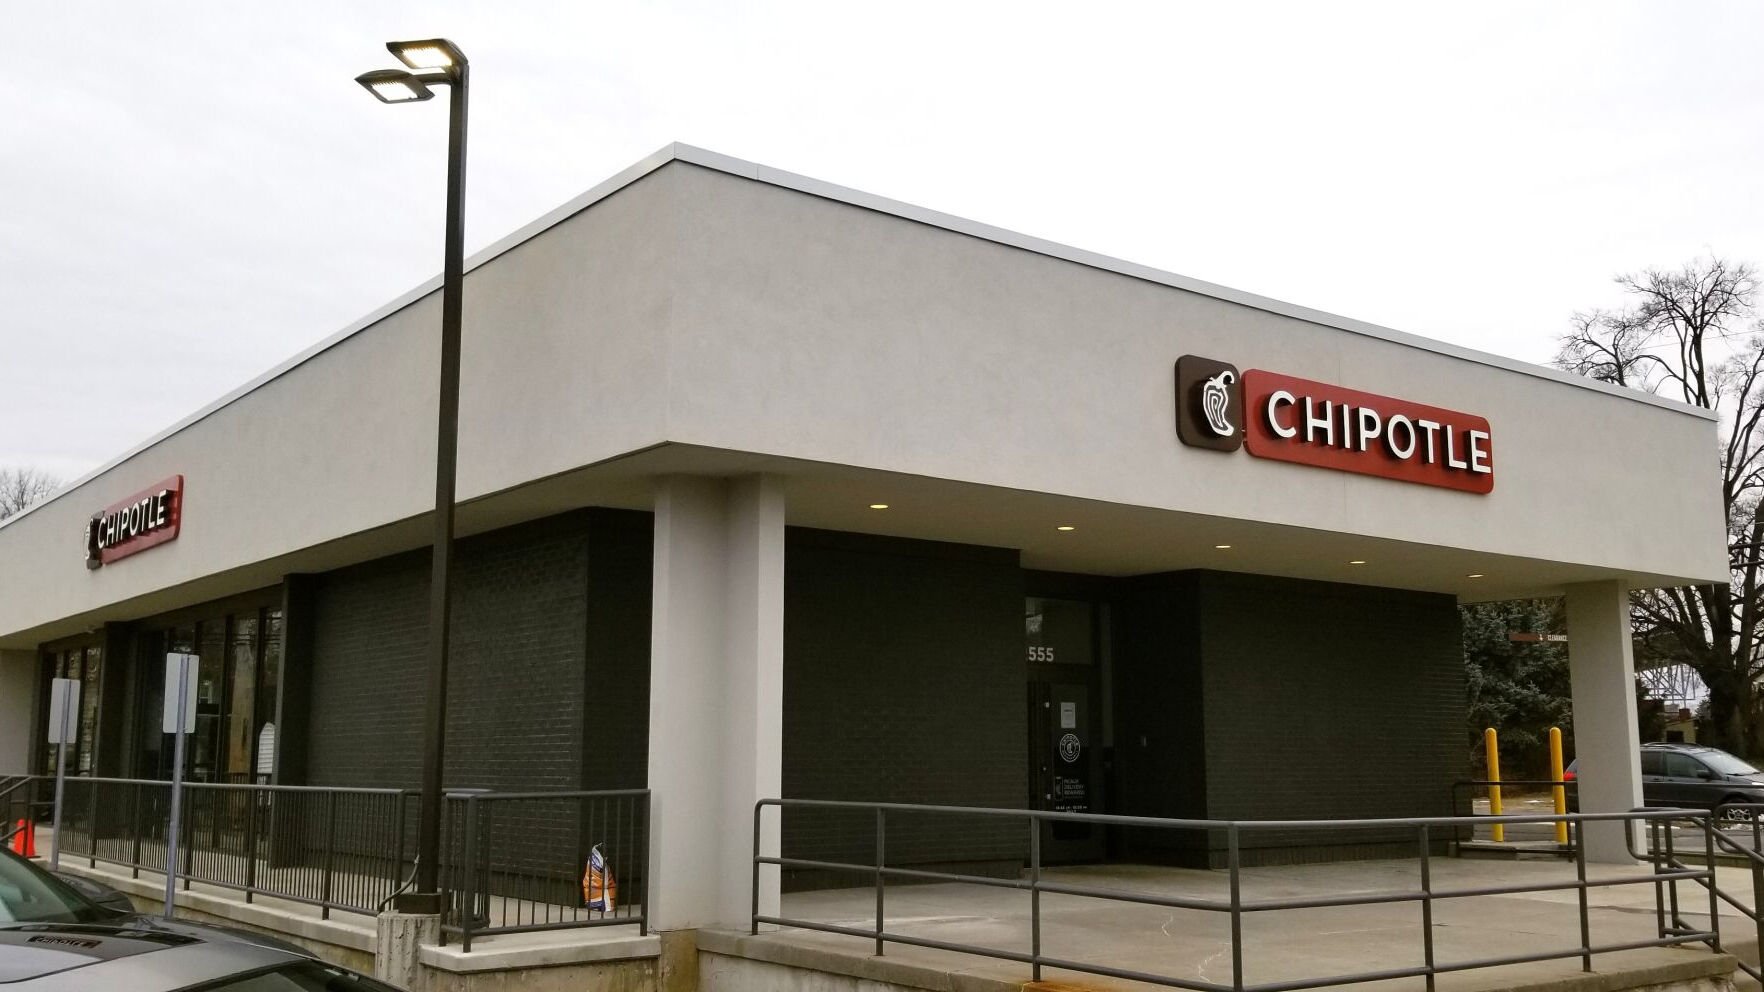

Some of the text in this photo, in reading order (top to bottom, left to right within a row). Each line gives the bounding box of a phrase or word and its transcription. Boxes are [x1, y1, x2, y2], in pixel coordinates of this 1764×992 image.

[1267, 390, 1491, 474] CHIPOTLE
[97, 489, 167, 549] CHIPOTLE
[1026, 646, 1054, 662] 555
